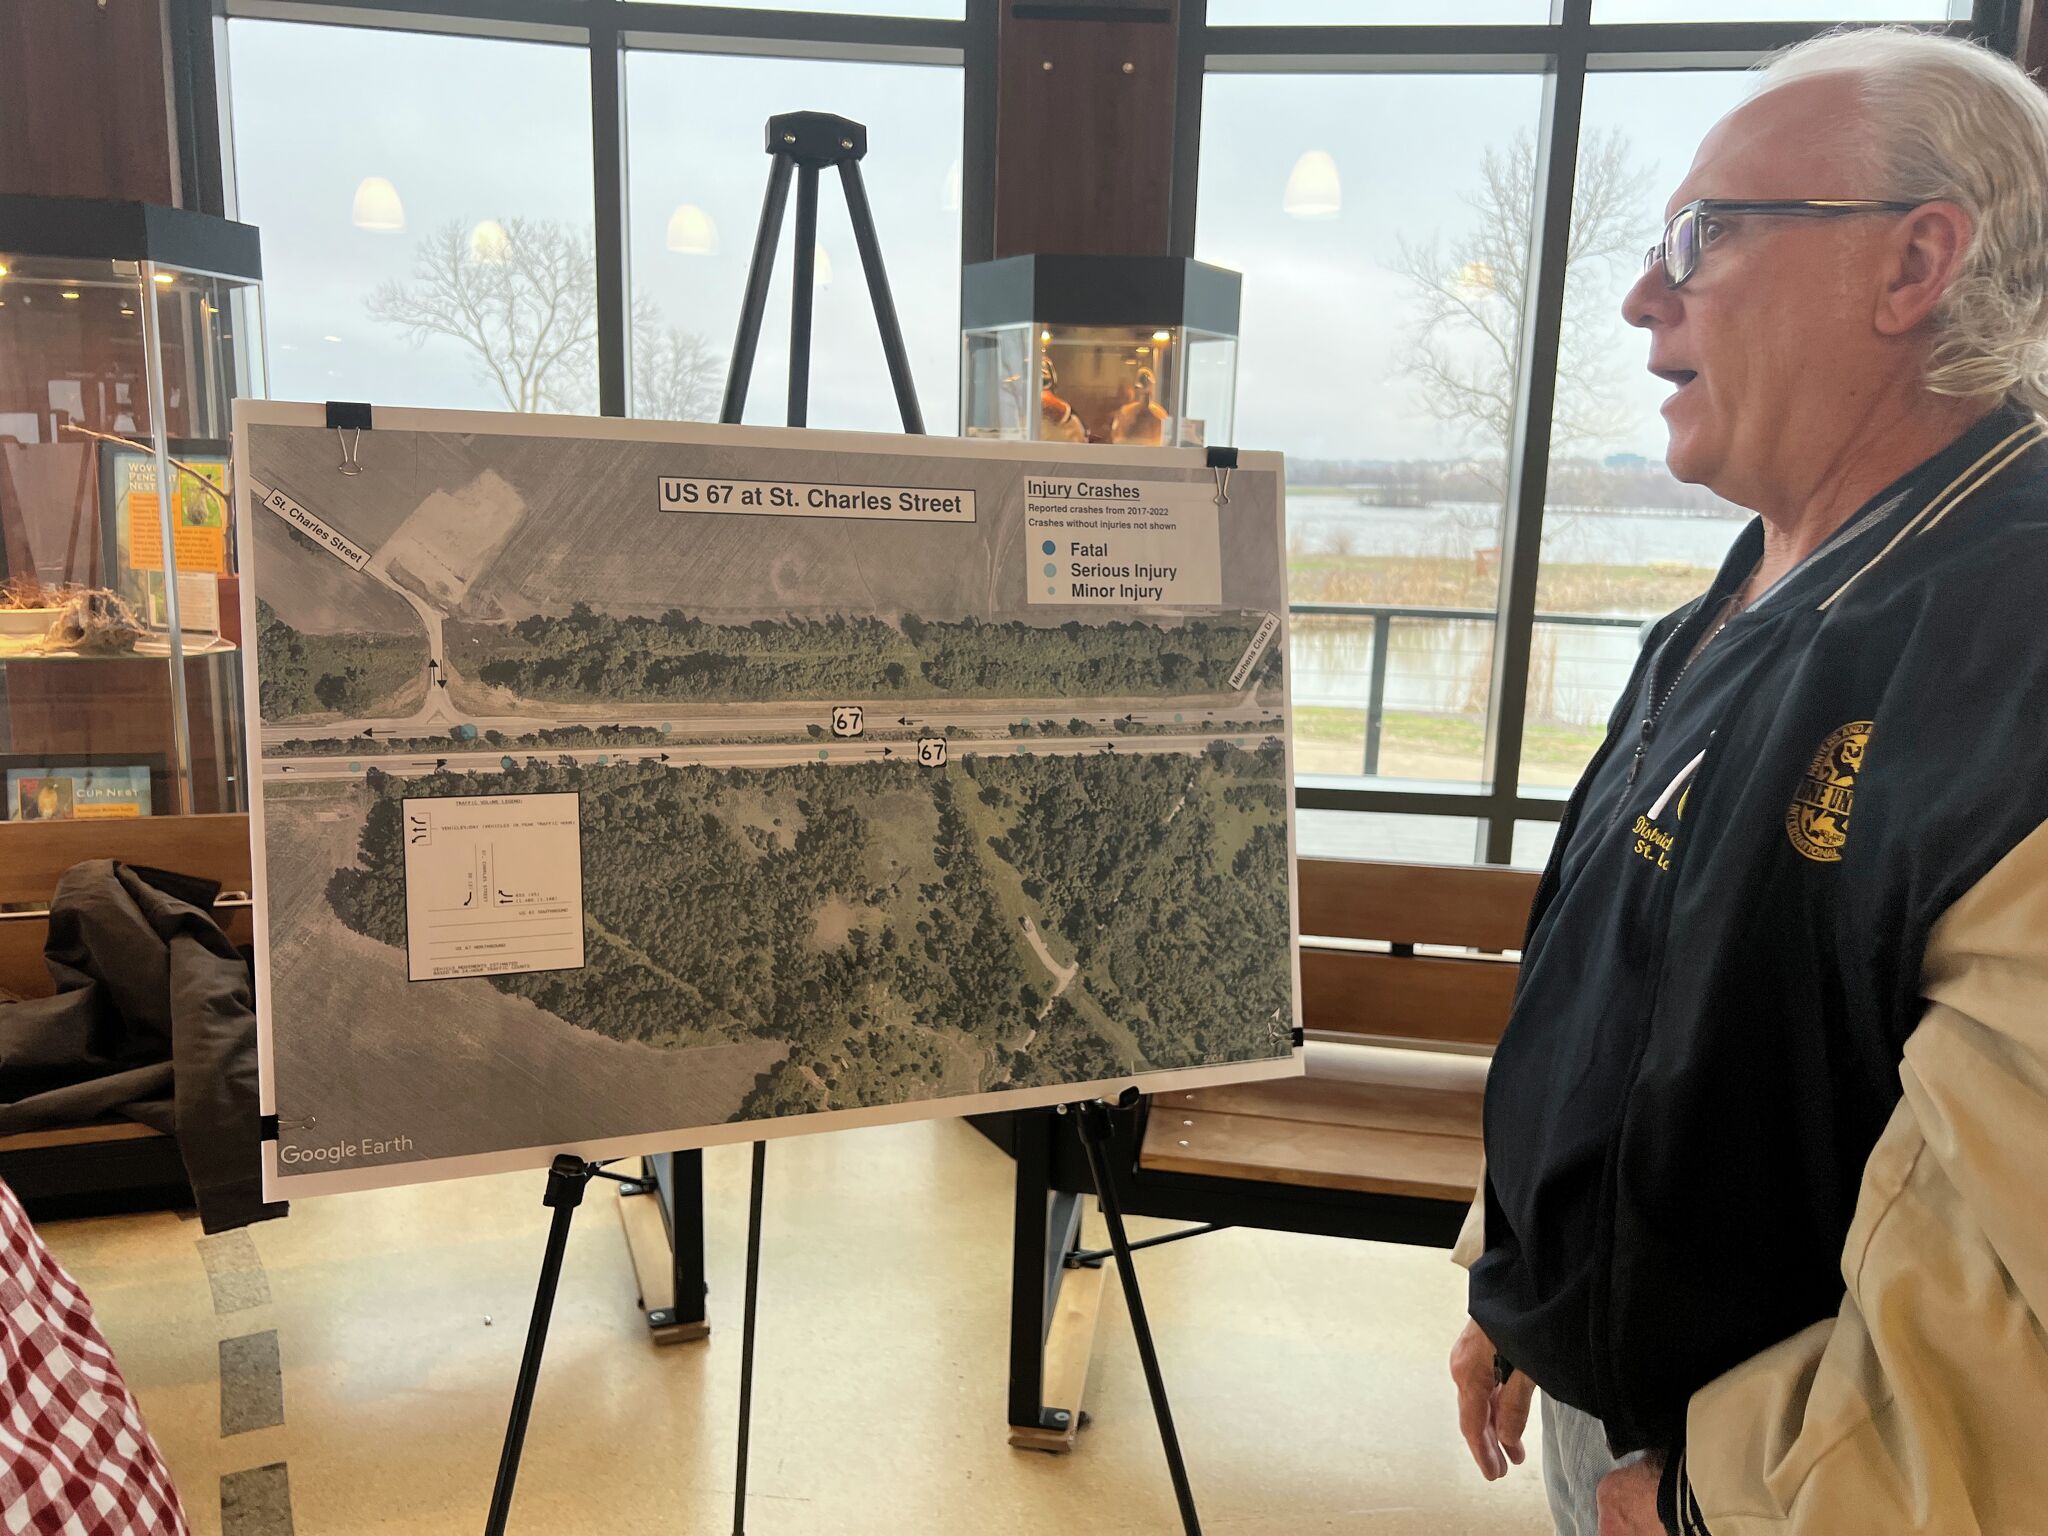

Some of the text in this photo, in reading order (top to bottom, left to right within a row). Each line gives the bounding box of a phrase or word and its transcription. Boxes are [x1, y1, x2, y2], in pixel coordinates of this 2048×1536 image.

[664, 482, 962, 513] US 67 at St. Charles Street
[1027, 480, 1140, 499] Injury Crashes
[1028, 503, 1169, 516] Reported crashes from 2017-2022
[271, 495, 362, 564] St. Charles Street
[1028, 518, 1177, 531] Crashes without injuries not shown
[1071, 542, 1108, 557] Fatal
[1071, 563, 1178, 581] Serious Injury
[1071, 583, 1163, 601] Minor Injury
[1253, 631, 1267, 650] Club
[836, 713, 860, 730] 67
[921, 744, 944, 761] 67
[280, 1135, 413, 1164] Google Earth
